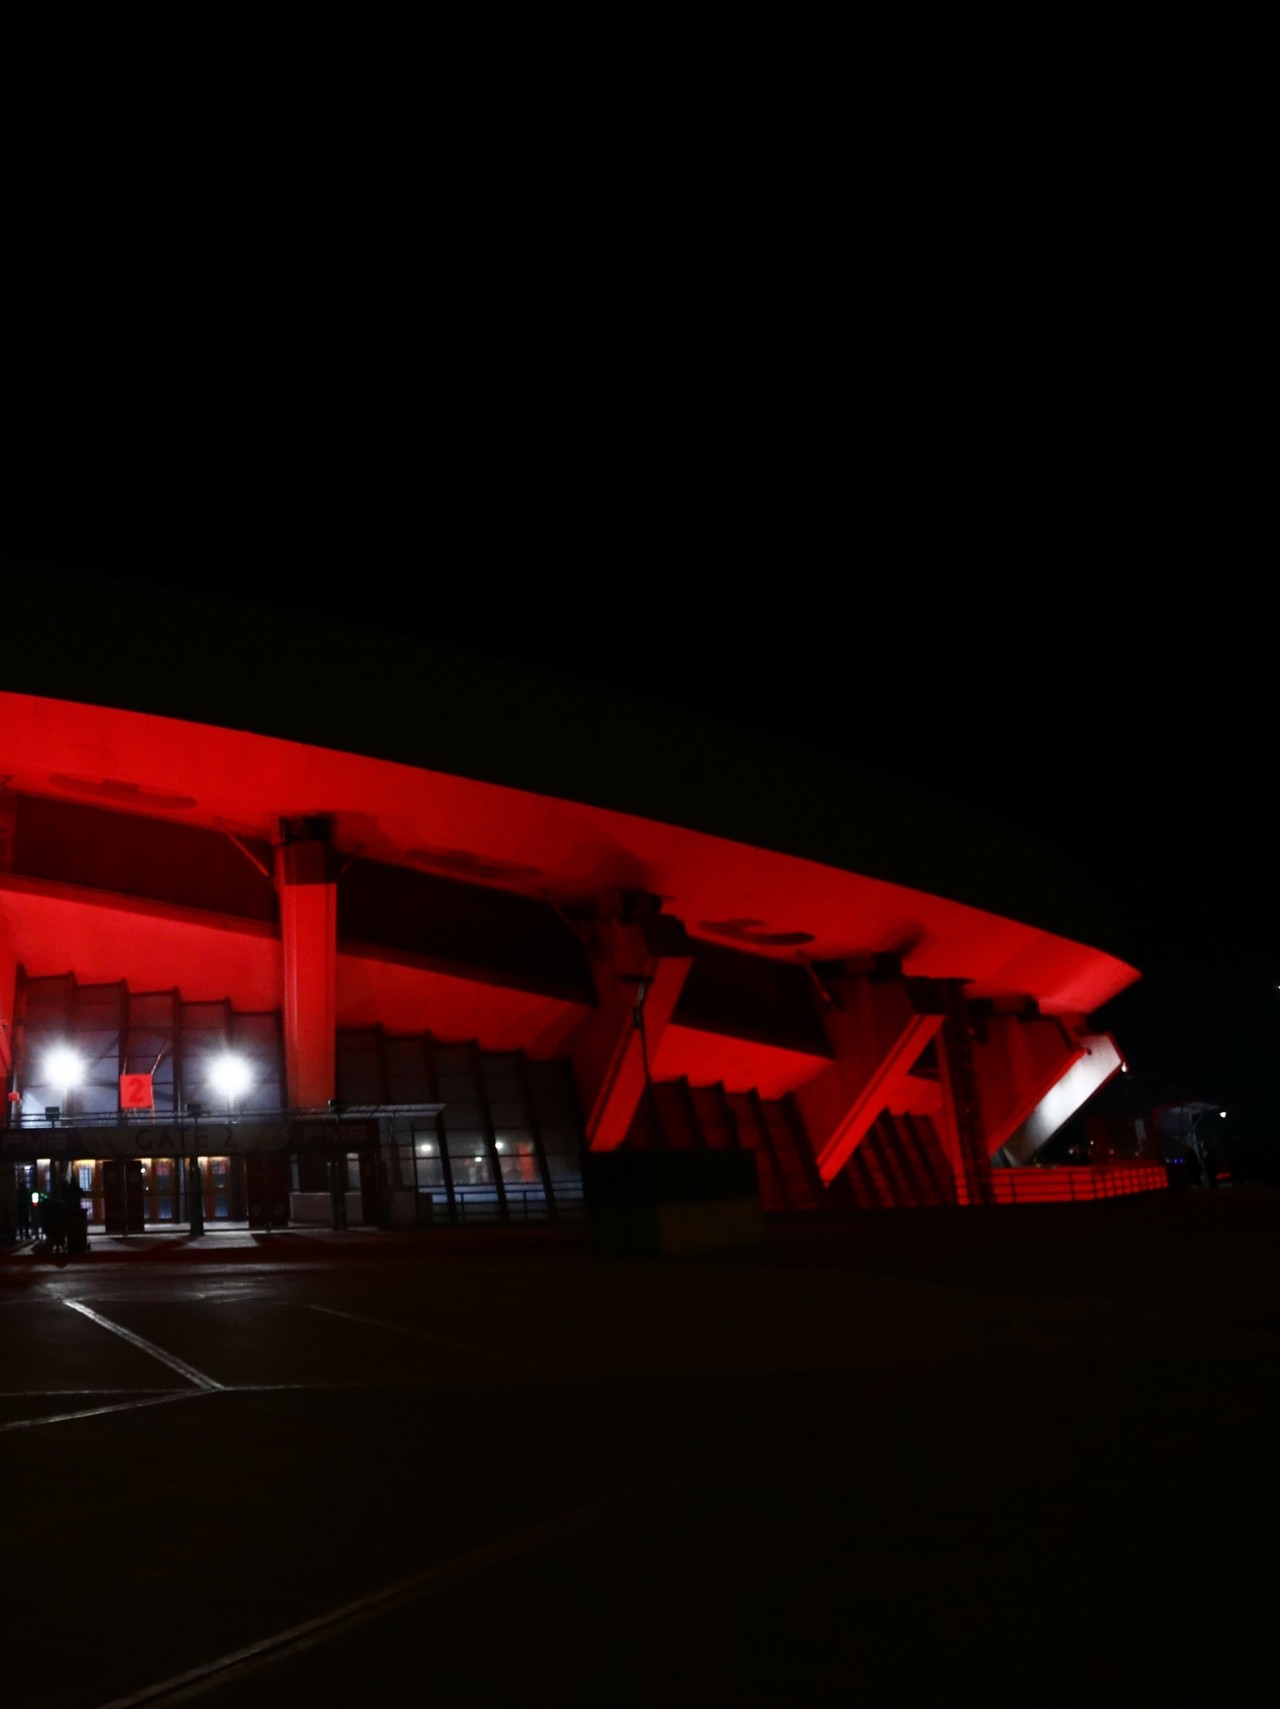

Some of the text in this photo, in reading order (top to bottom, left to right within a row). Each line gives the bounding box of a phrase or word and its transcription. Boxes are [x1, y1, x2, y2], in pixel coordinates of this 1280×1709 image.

[128, 1077, 145, 1104] 2
[135, 1128, 237, 1151] GATE 2
